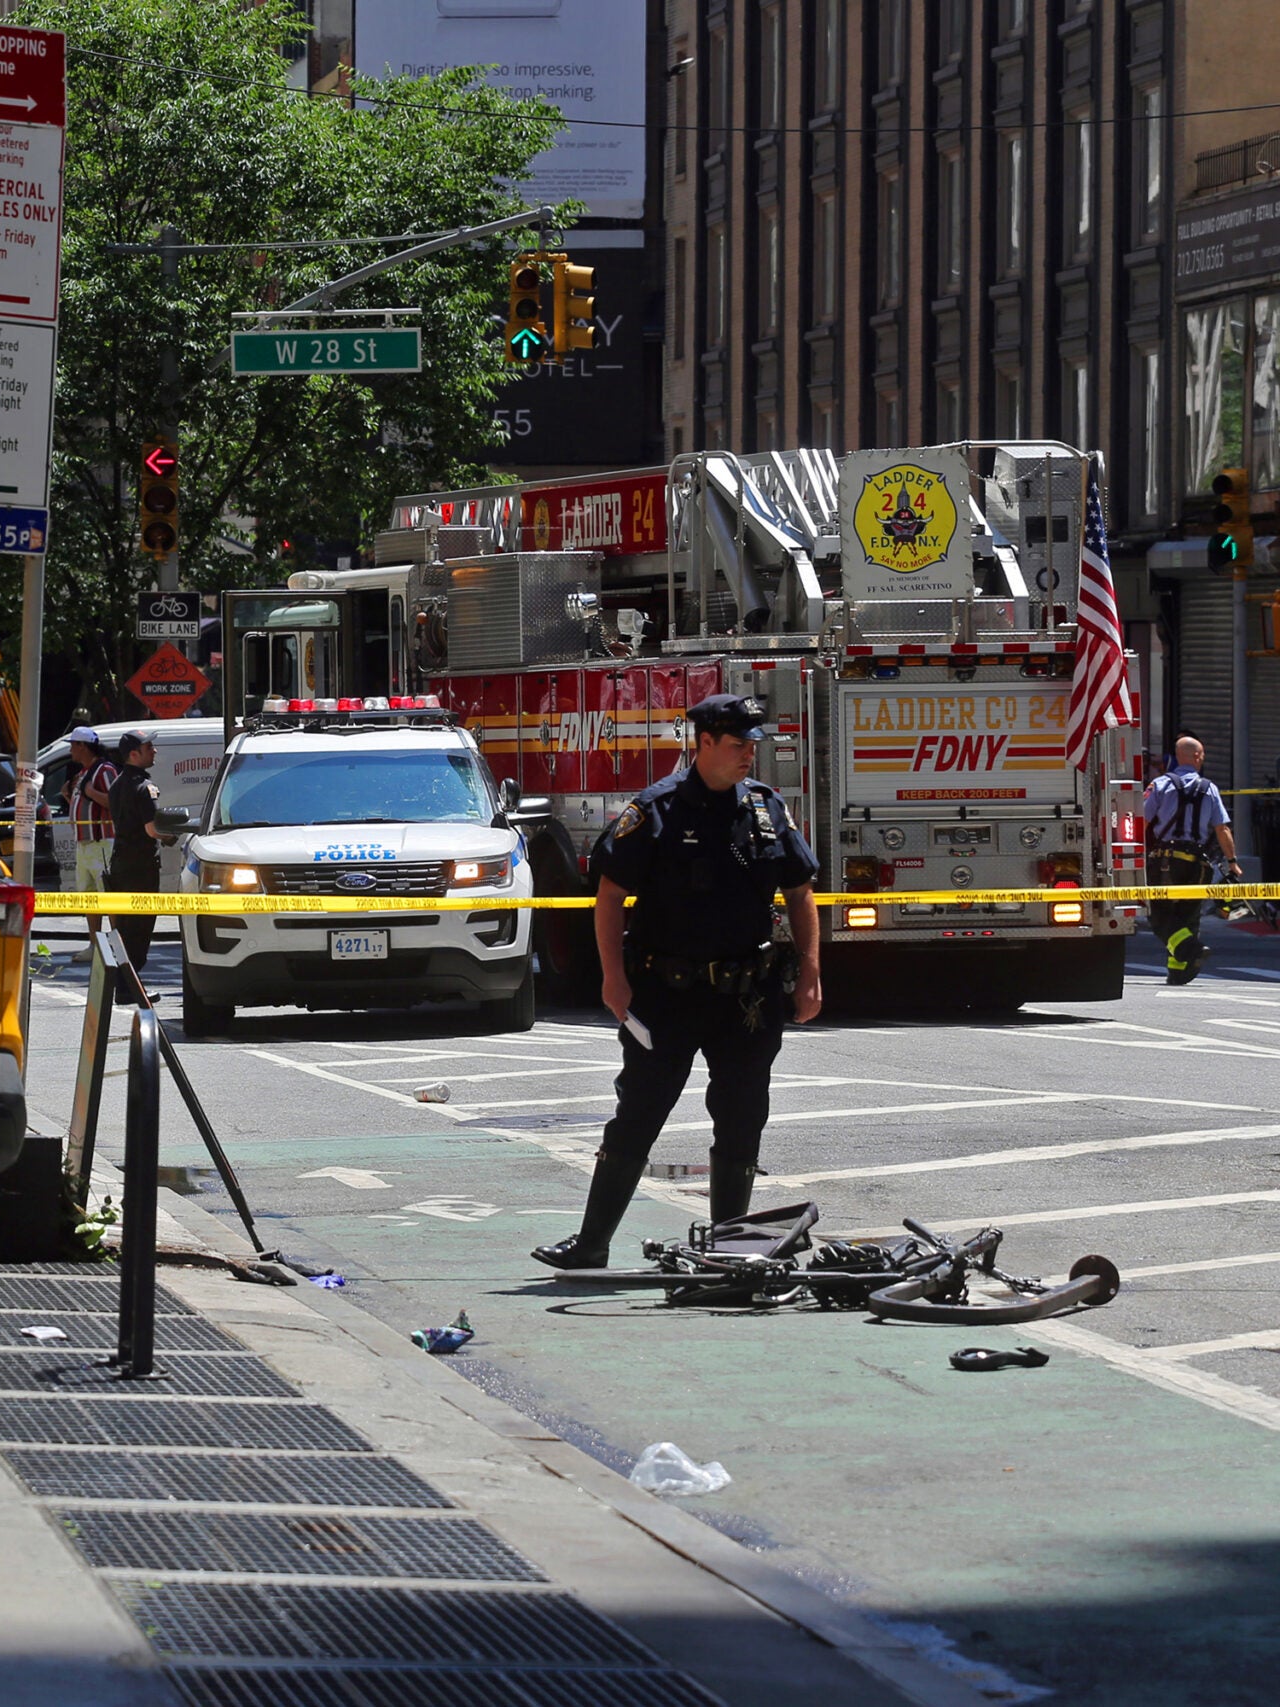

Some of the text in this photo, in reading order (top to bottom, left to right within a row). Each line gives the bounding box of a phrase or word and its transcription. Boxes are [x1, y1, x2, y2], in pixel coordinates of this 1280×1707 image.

[401, 63, 448, 79] Digital
[493, 65, 509, 76] so
[514, 63, 595, 82] impressive,
[536, 84, 596, 101] banking.
[22, 203, 57, 223] ONLY
[4, 229, 36, 247] Friday
[275, 338, 378, 365] W 28 St
[873, 471, 934, 492] LADDER
[561, 488, 655, 549] LADDER 24
[870, 535, 942, 548] F.D. N.Y.
[881, 553, 933, 569] SAY NO MORE
[899, 582, 952, 592] SCARENTINO
[140, 622, 197, 635] BIKE LANE
[145, 684, 192, 693] WORK ZONE
[155, 700, 183, 709] AHEAD
[853, 696, 977, 731] LADDER
[1028, 696, 1067, 729] 24
[558, 710, 605, 752] FDNY
[912, 734, 1009, 772] FDNY
[174, 757, 213, 776] AUTOTAP
[902, 789, 1020, 800] KEEP BACK 200 FEET
[313, 849, 396, 862] POLICE
[344, 876, 368, 886] Ford
[335, 937, 383, 952] 4271 17
